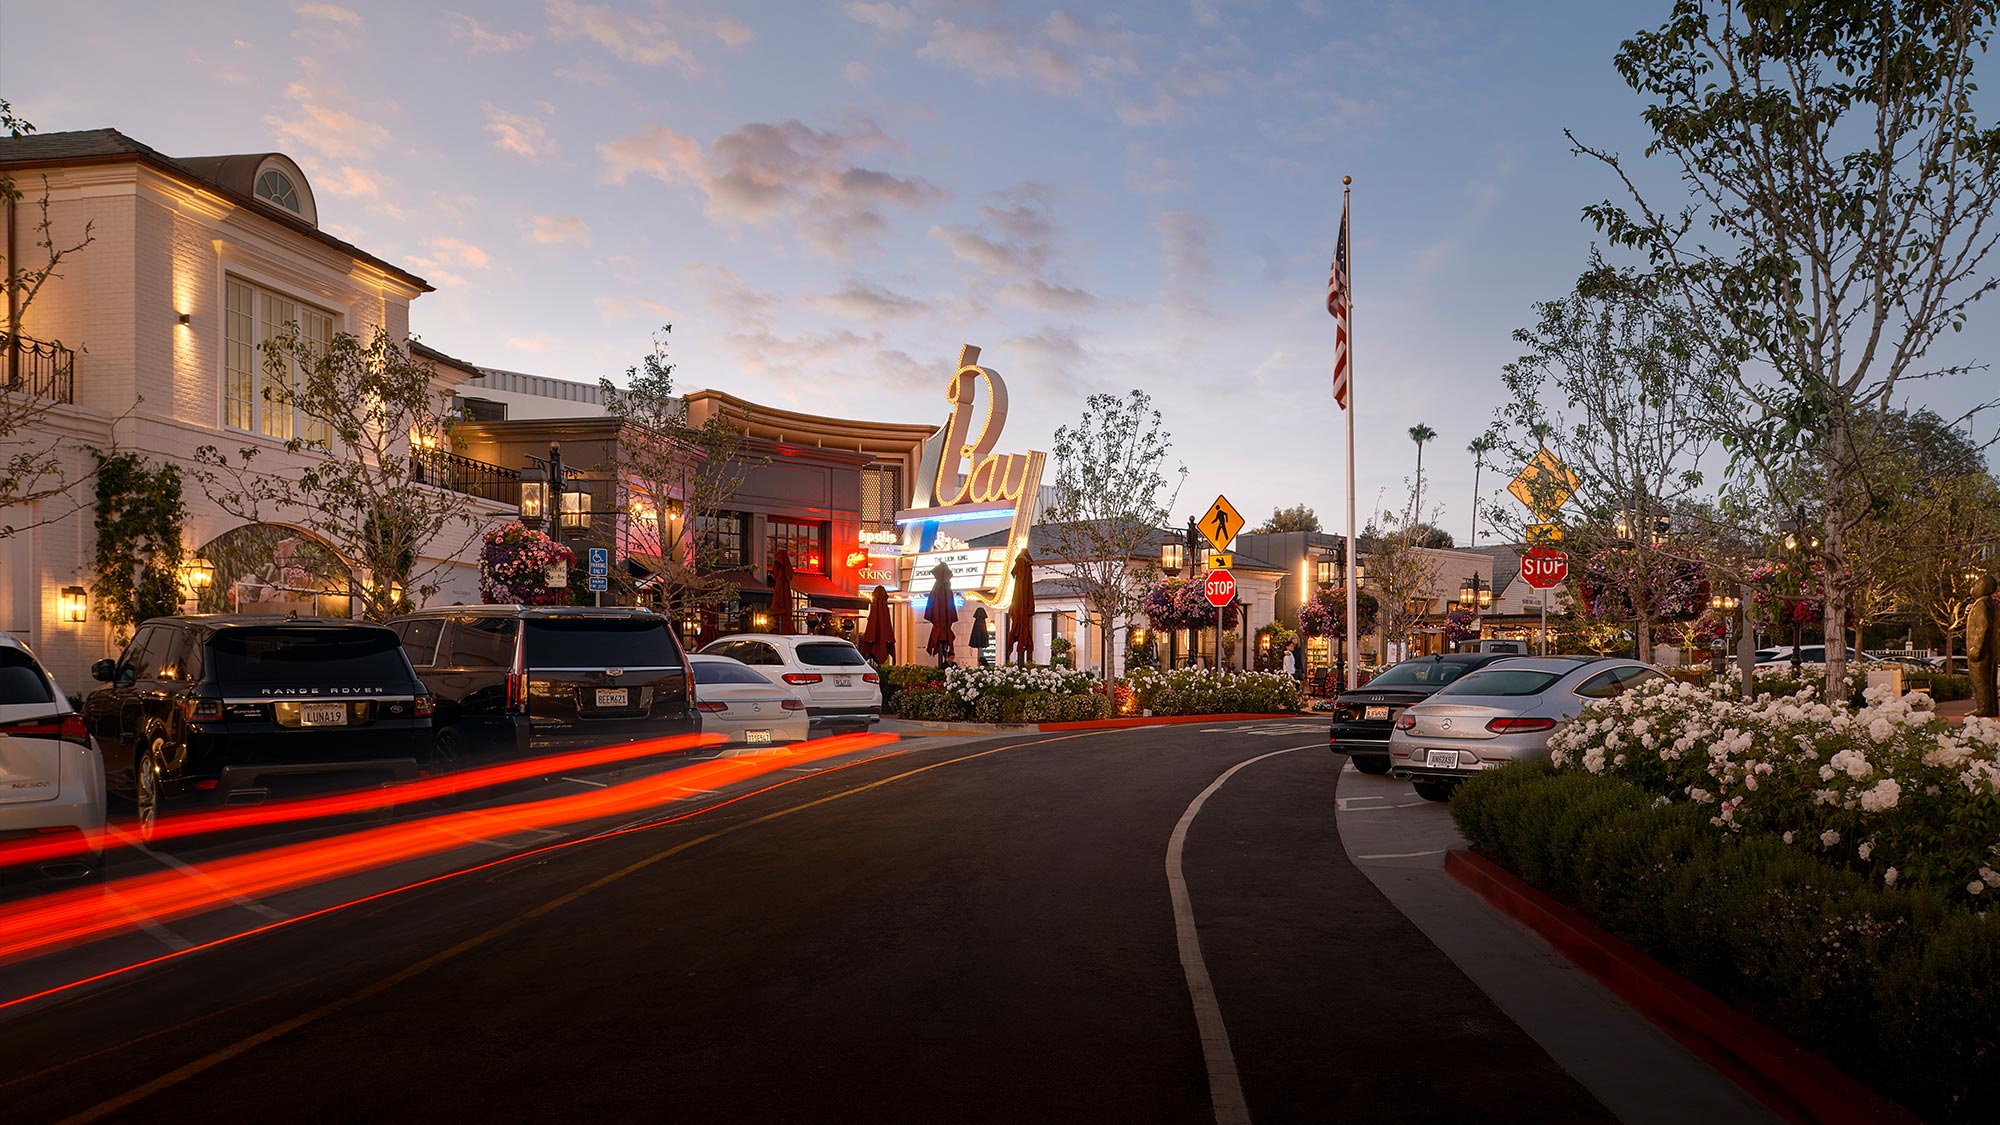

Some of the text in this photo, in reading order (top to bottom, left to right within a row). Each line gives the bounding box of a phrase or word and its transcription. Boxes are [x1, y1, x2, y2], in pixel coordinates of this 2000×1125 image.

[935, 344, 1046, 608] Bay
[1524, 557, 1564, 575] STOP
[867, 570, 892, 580] KING
[1207, 581, 1233, 595] STOP
[307, 711, 341, 723] LUNA19
